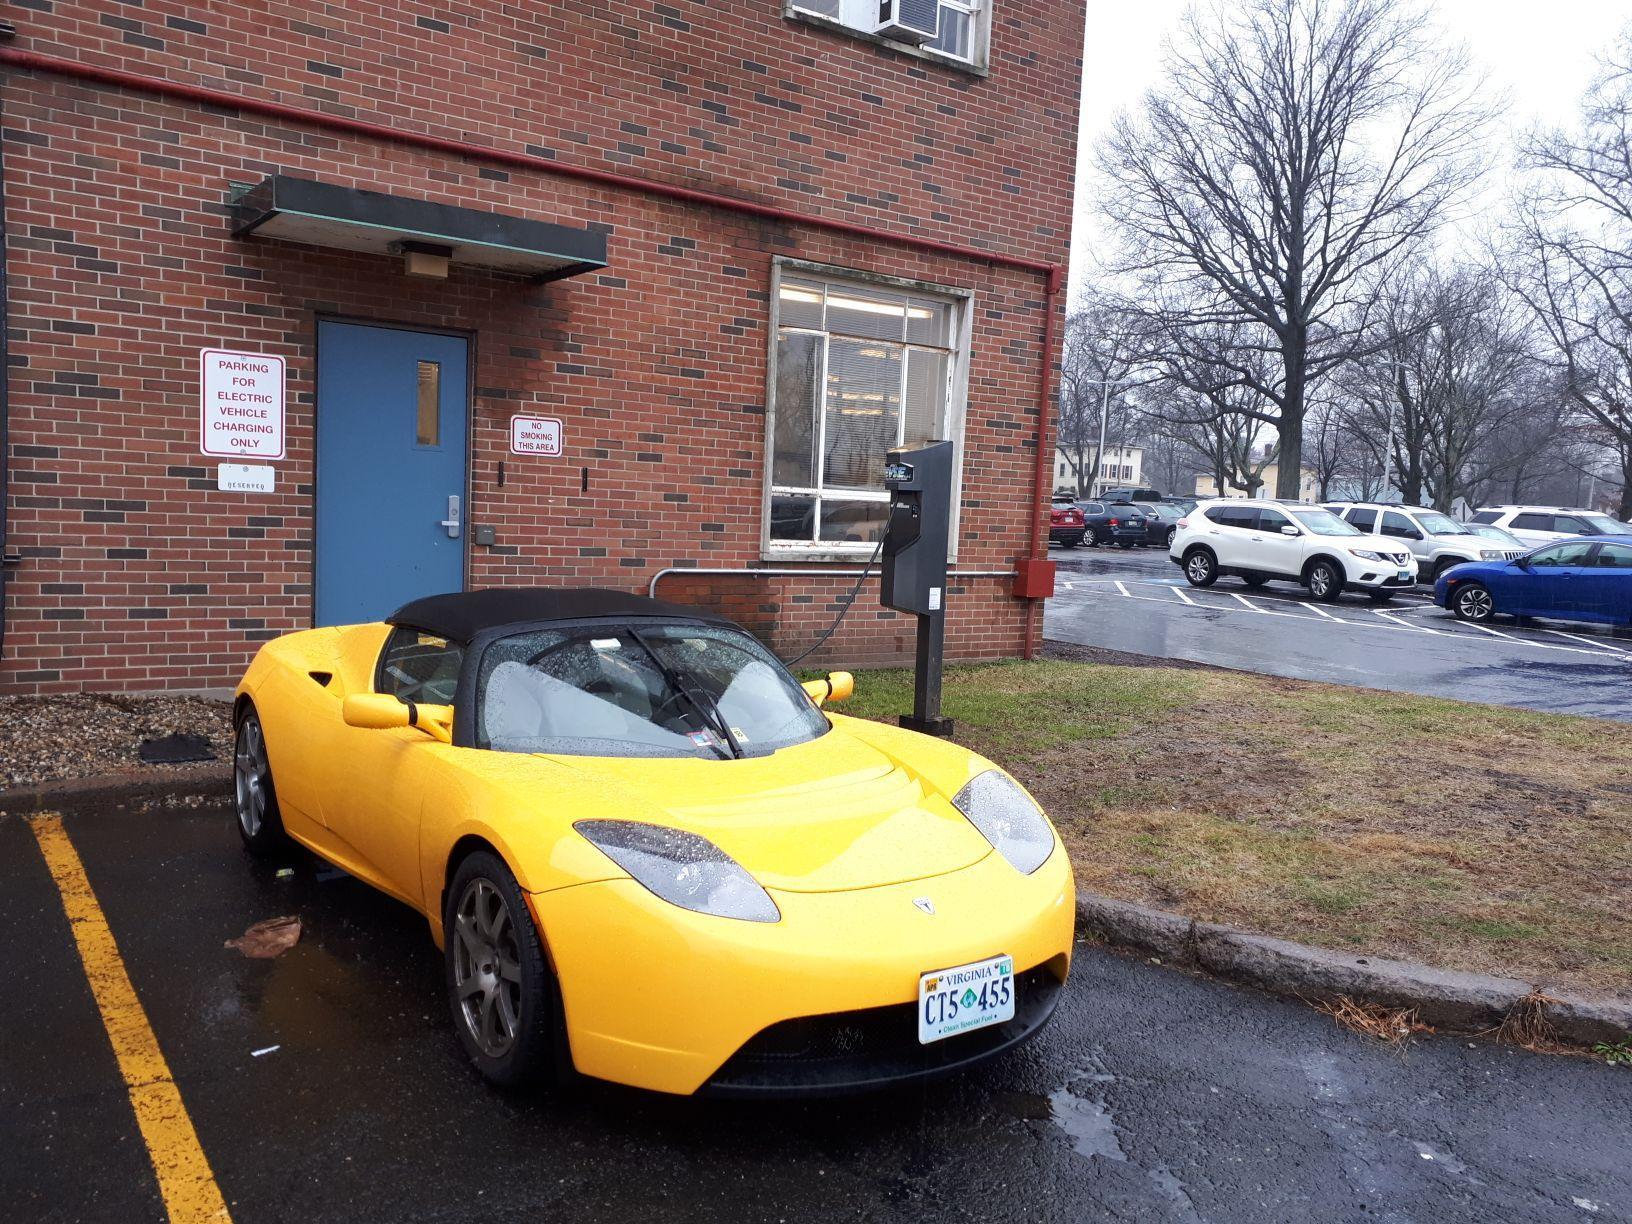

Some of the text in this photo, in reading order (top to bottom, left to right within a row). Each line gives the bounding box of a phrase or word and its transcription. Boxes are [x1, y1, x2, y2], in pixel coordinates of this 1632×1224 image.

[219, 361, 269, 373] PARKING
[232, 377, 255, 387] FOR
[218, 391, 273, 404] ELECTRIC
[219, 406, 268, 418] VEHICLE
[213, 421, 273, 434] CHARGING
[531, 422, 541, 430] NO
[520, 431, 553, 441] SMOKING
[230, 438, 260, 448] ONLY
[518, 441, 555, 451] THIS AREA
[946, 966, 992, 987] VIRGINIA
[925, 976, 1010, 1025] CT5 455
